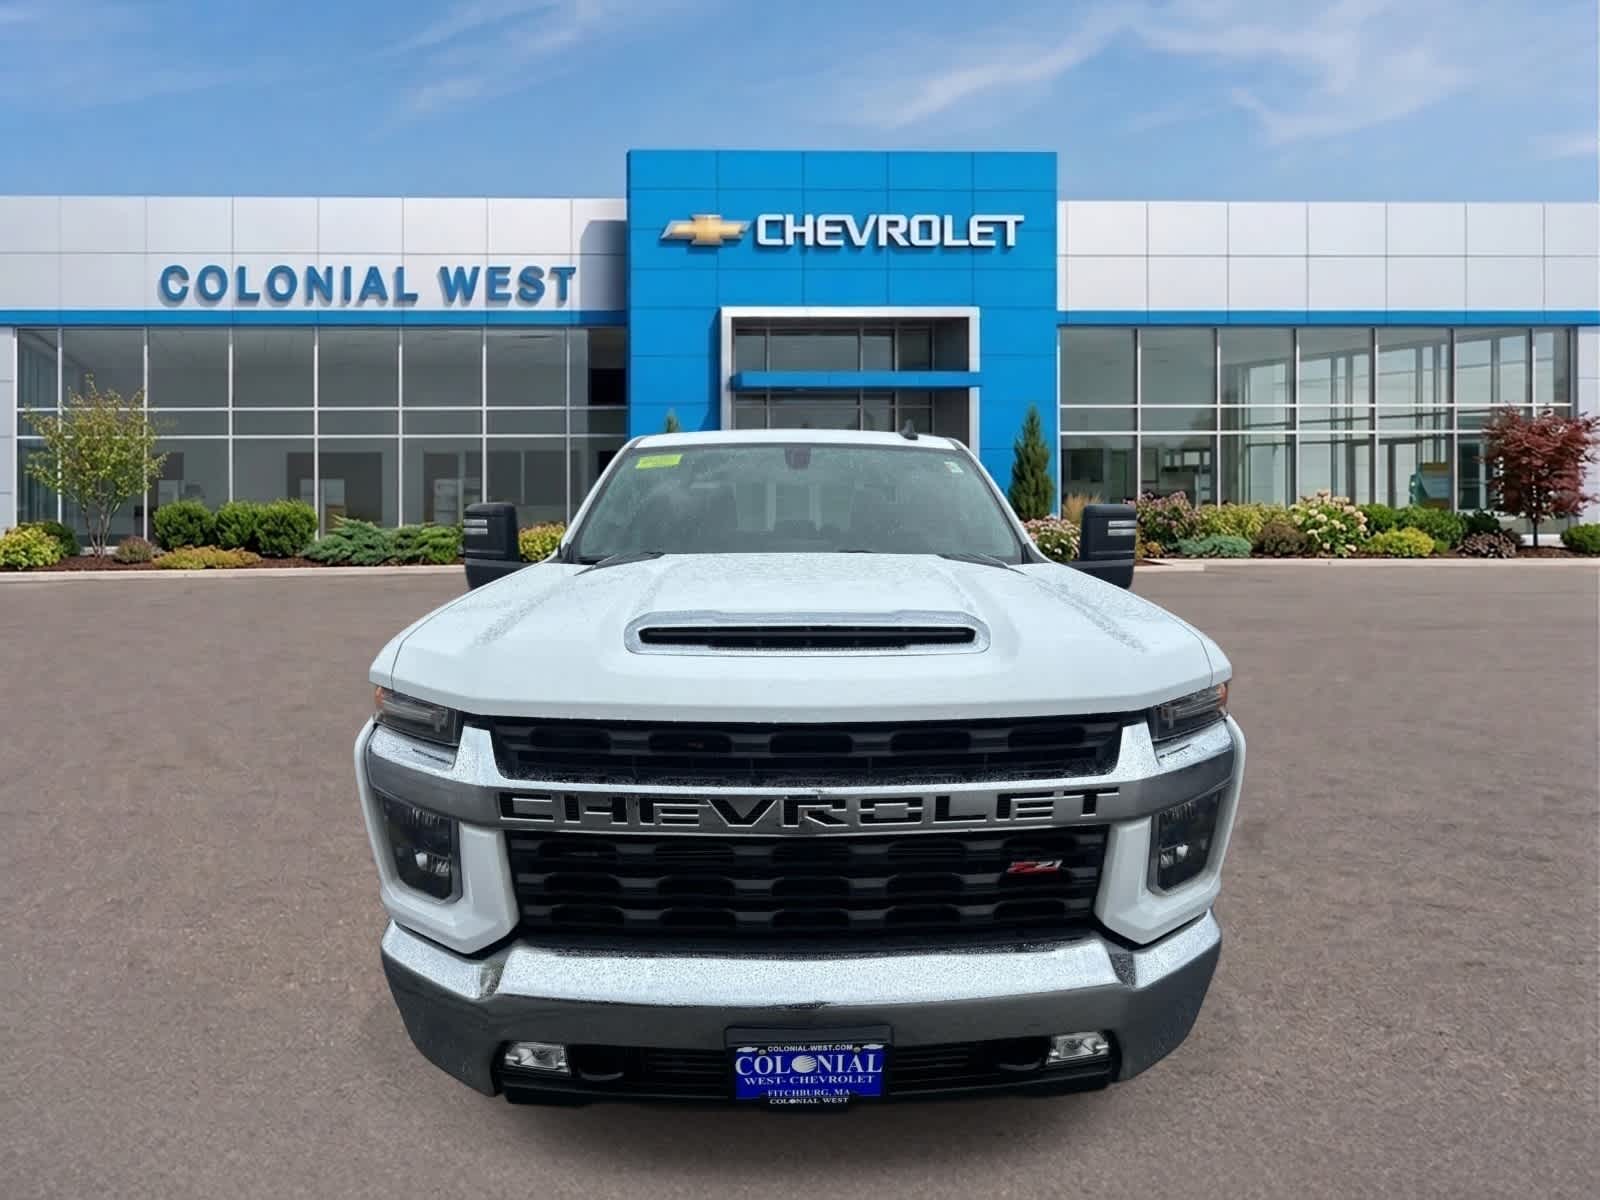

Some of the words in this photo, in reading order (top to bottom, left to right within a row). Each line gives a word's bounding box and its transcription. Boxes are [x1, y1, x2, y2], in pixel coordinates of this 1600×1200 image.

[756, 213, 1025, 248] CHEVROLET
[159, 264, 418, 304] COLONIAL
[437, 264, 577, 304] WEST
[499, 787, 1120, 828] CHEVROLET
[735, 1054, 882, 1076] COLONIAL
[834, 1088, 850, 1097] MA
